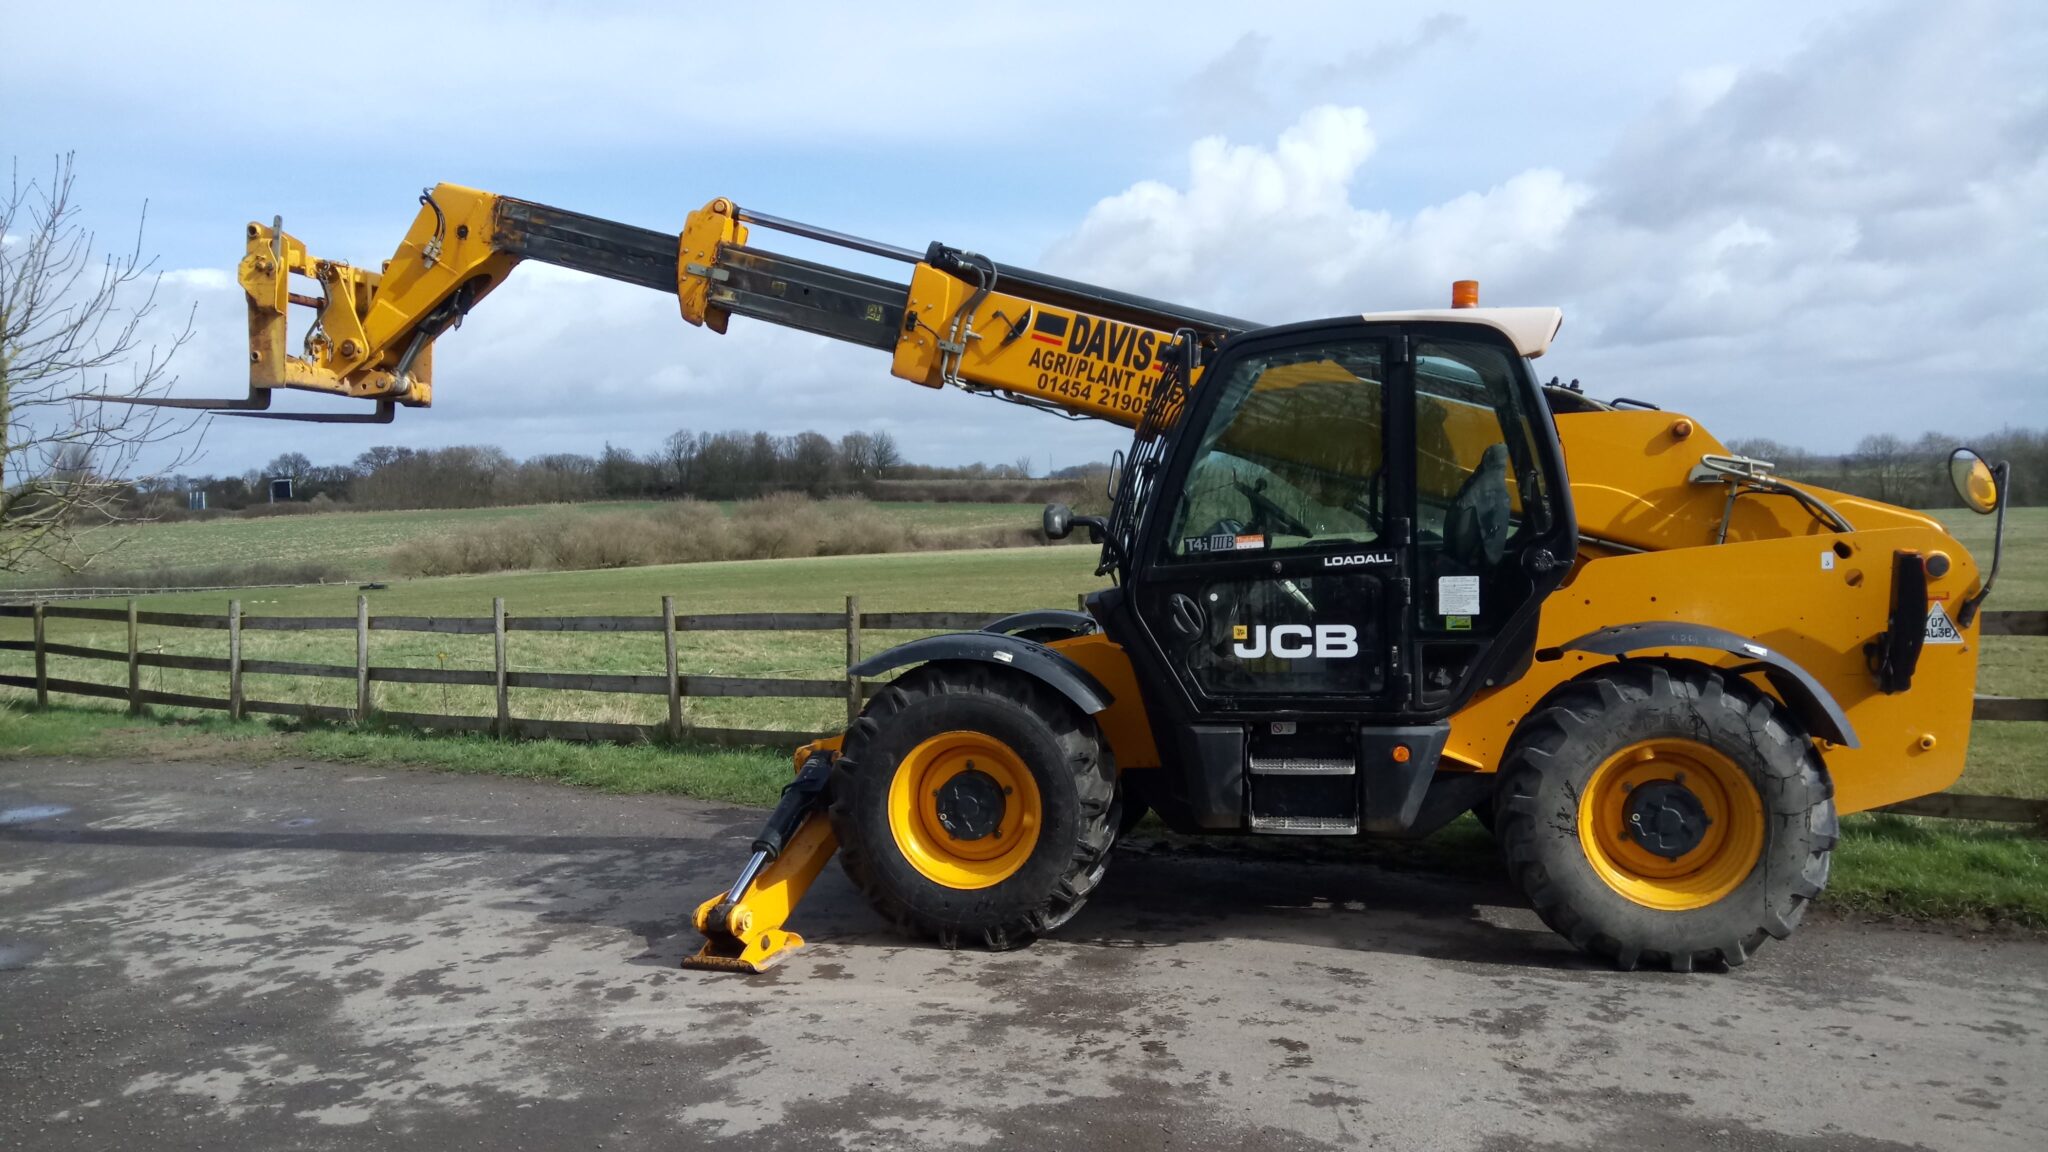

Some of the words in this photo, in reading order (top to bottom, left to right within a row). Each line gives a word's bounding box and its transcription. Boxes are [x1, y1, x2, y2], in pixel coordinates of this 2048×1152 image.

[1067, 313, 1156, 372] DAVIS
[1029, 347, 1136, 392] AGRI/PLANT
[1037, 373, 1092, 401] 01454
[1185, 537, 1209, 552] T4i
[1324, 553, 1393, 567] LOADALL
[1931, 617, 1944, 628] 07
[1233, 624, 1359, 658] JCB
